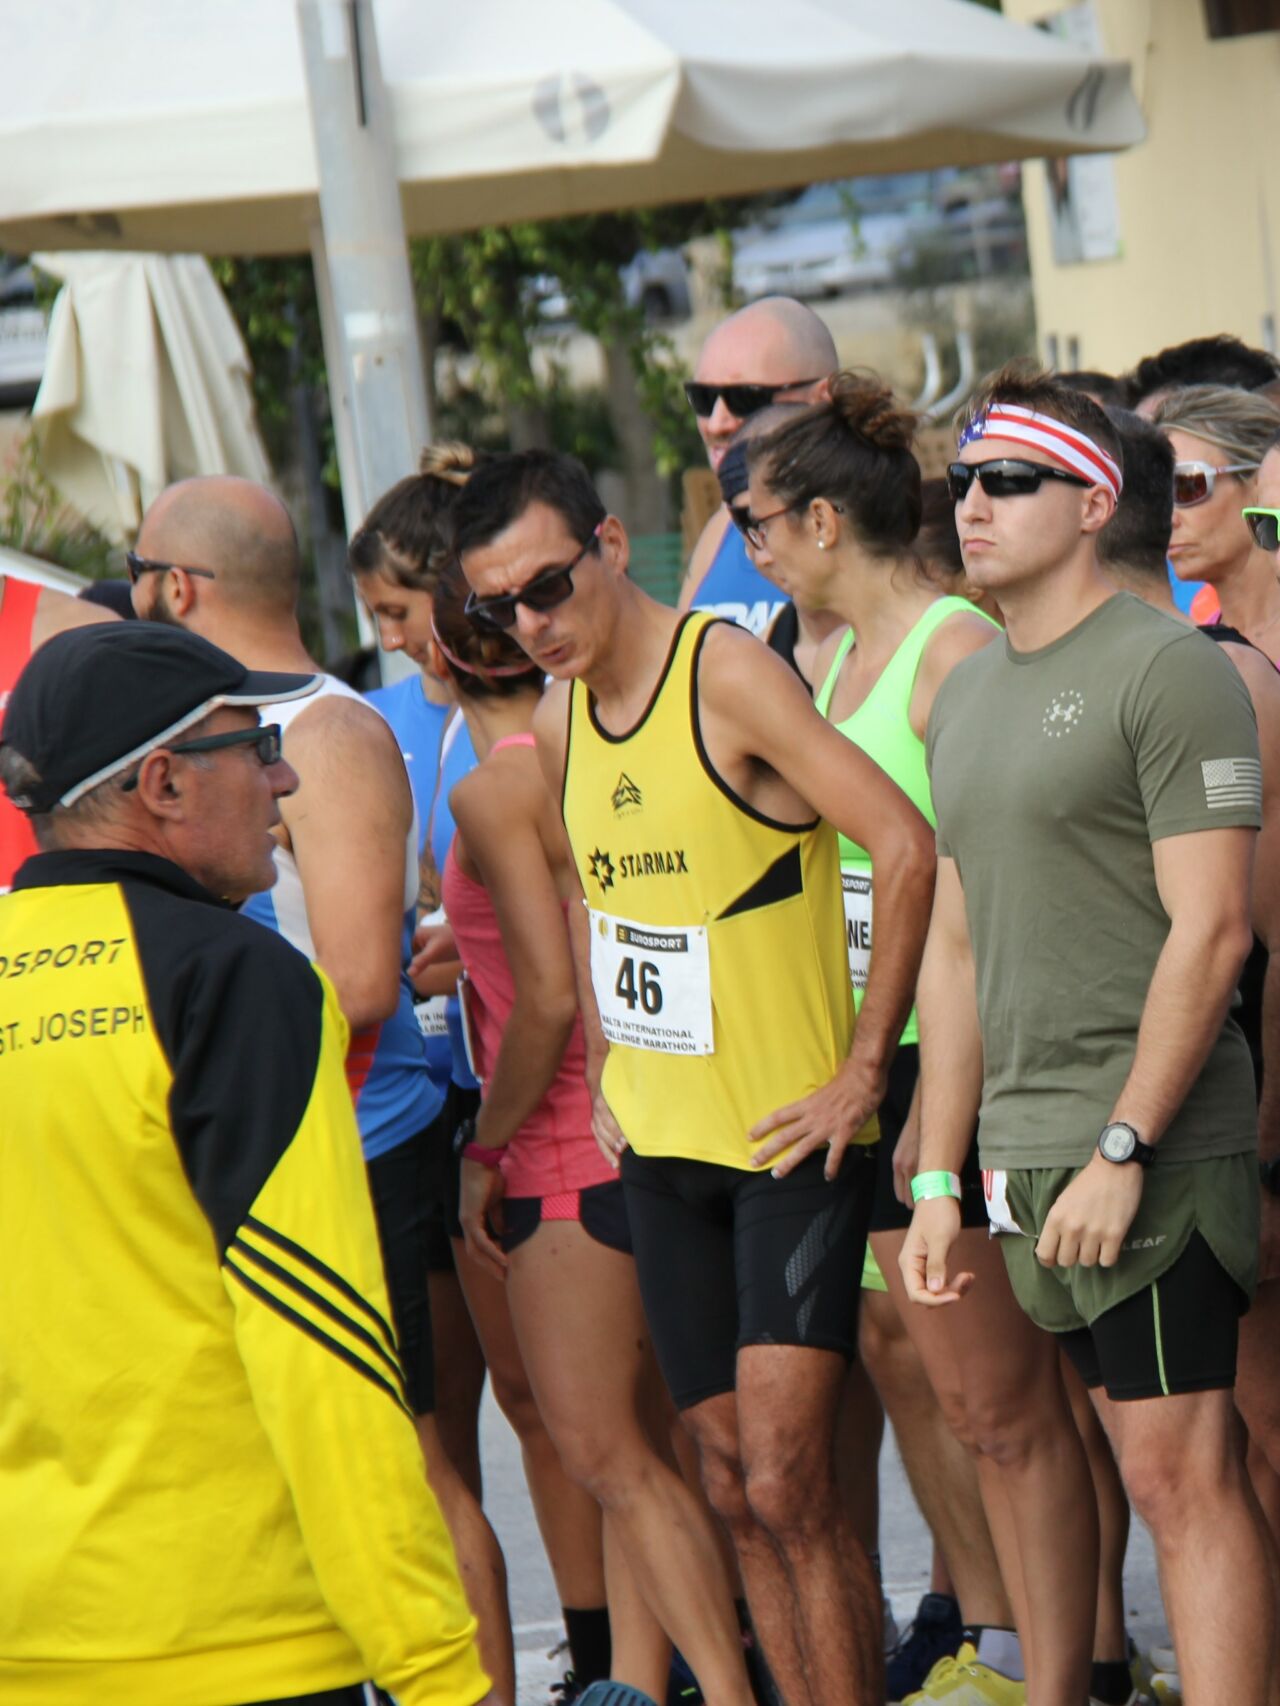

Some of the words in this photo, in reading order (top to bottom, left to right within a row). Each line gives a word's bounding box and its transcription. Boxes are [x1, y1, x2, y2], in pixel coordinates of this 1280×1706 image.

[619, 850, 689, 879] STARMAX
[630, 931, 681, 949] EUROSPORT
[616, 957, 663, 1015] 46
[31, 1005, 144, 1045] JOSEPH
[623, 1021, 694, 1039] INTERNATIONAL
[643, 1037, 696, 1051] MARATHON
